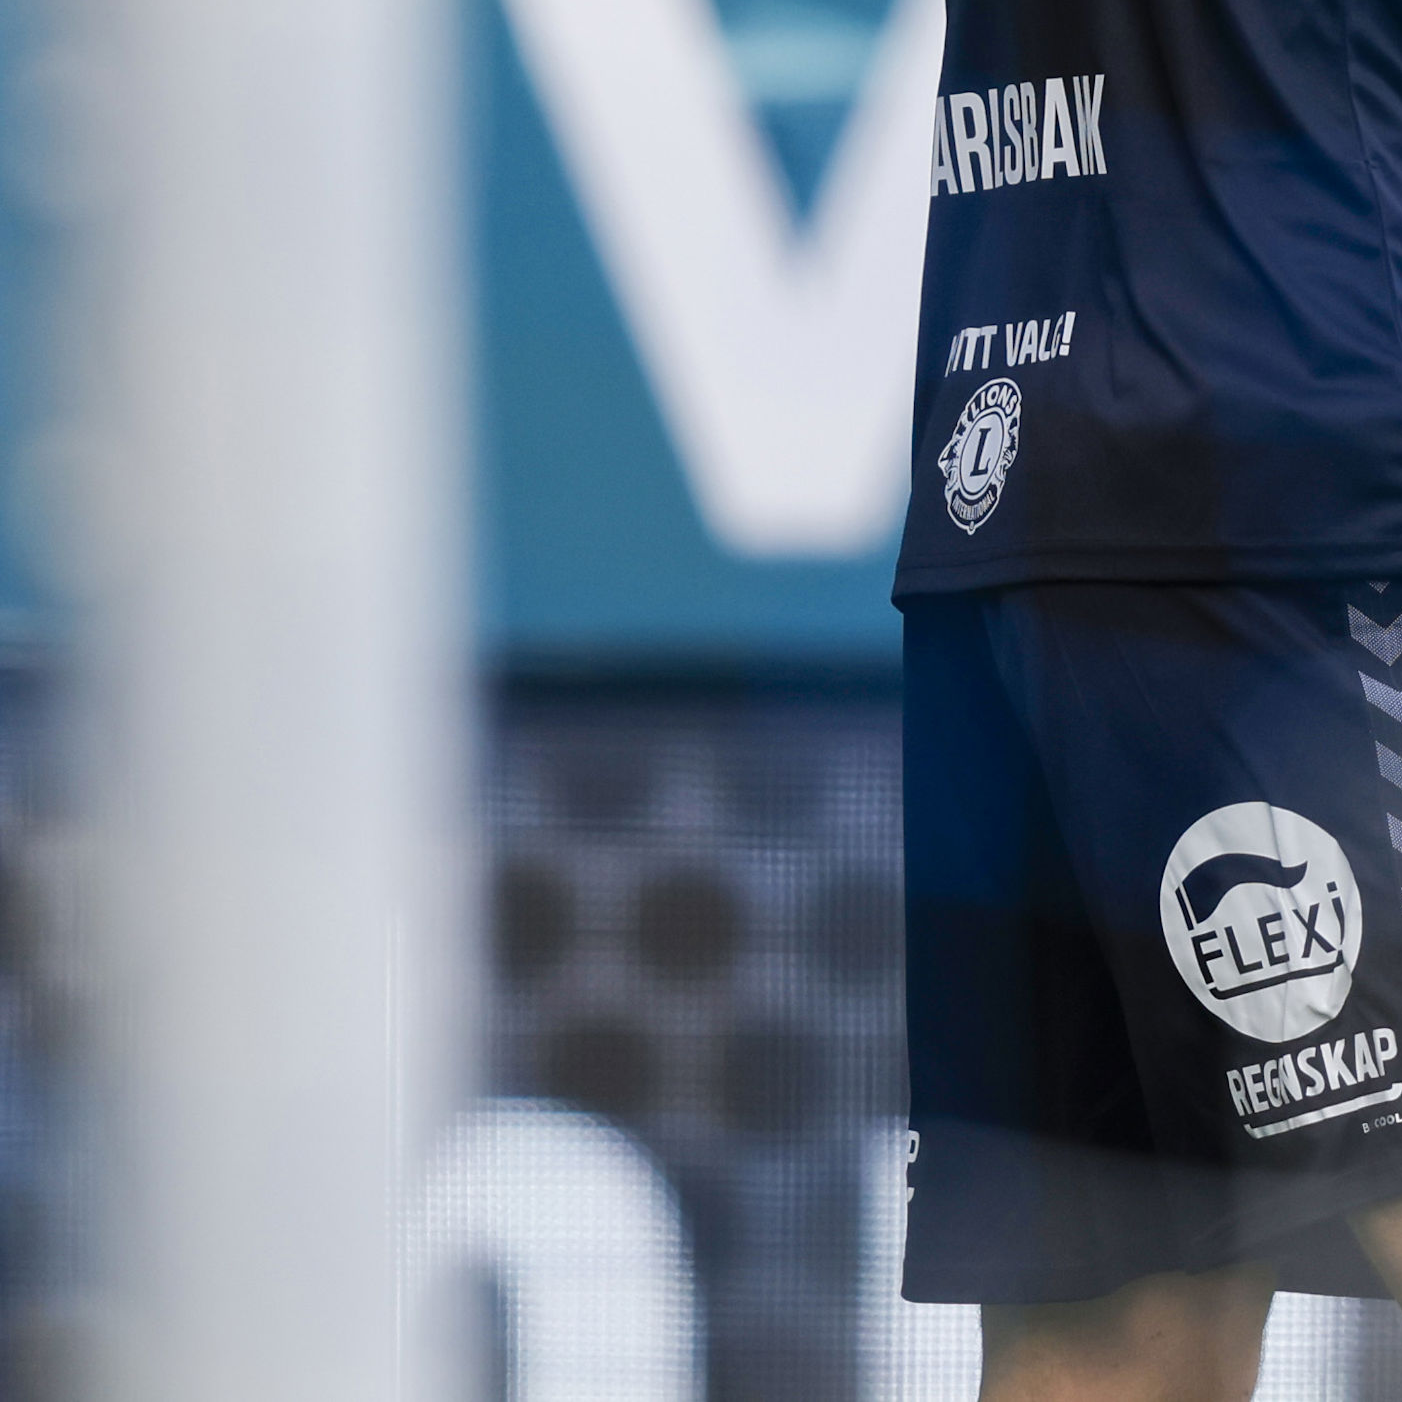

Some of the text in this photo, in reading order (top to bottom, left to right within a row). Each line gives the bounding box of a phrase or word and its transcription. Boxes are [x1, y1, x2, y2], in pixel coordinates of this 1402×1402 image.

[970, 384, 1018, 419] LIONS
[969, 427, 992, 477] L
[1226, 1027, 1399, 1117] REGNSKAP
